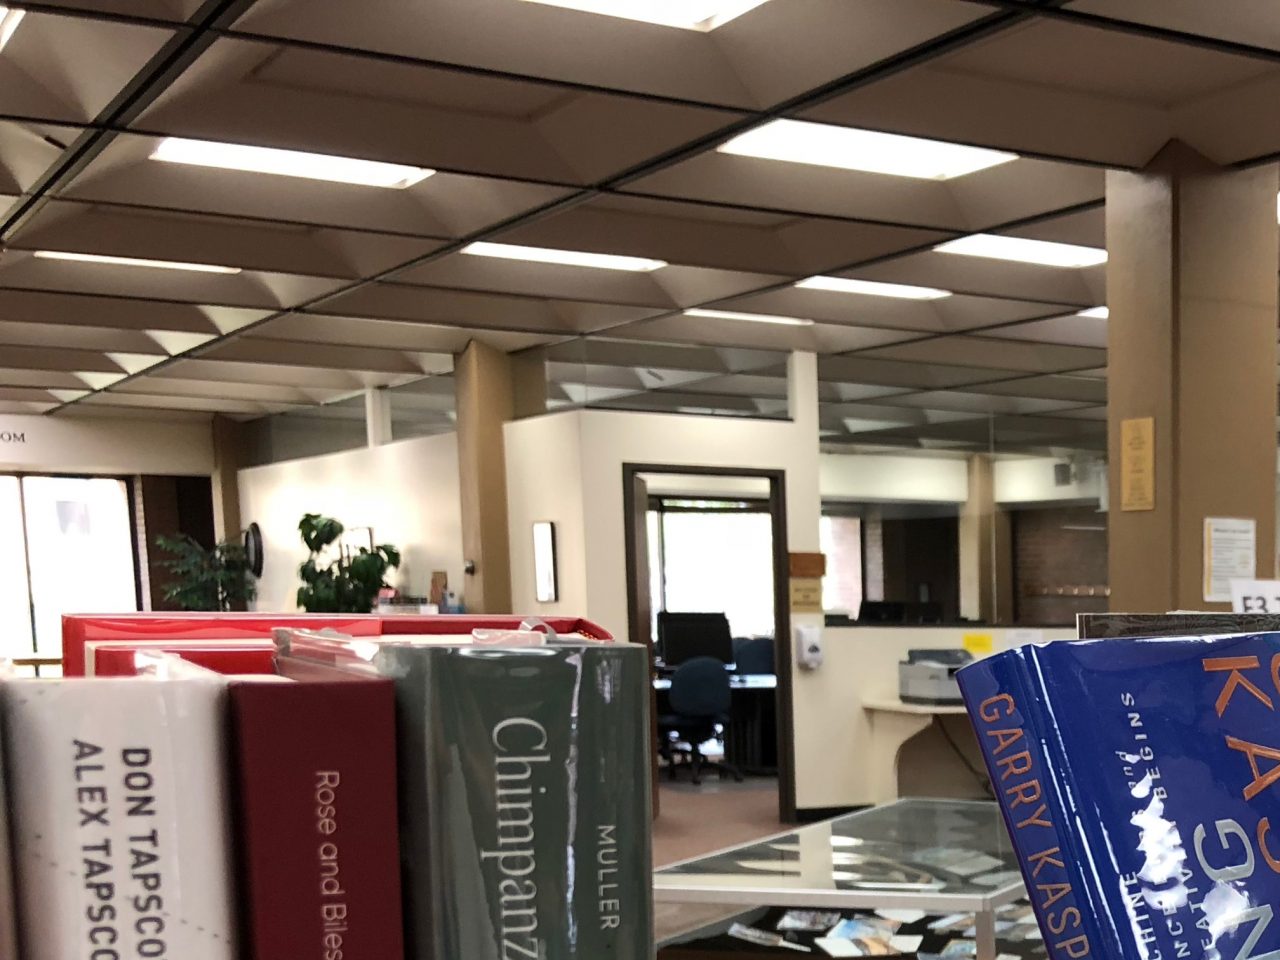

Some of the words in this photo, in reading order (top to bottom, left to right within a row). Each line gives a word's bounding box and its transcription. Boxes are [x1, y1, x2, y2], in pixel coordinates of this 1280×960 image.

[72, 739, 111, 826] ALEX
[121, 747, 156, 817] DON
[979, 692, 1053, 828] GARRY
[1121, 692, 1168, 800] BEGINS
[315, 770, 340, 835] Rose
[320, 843, 345, 895] and
[597, 825, 620, 930] MULLER
